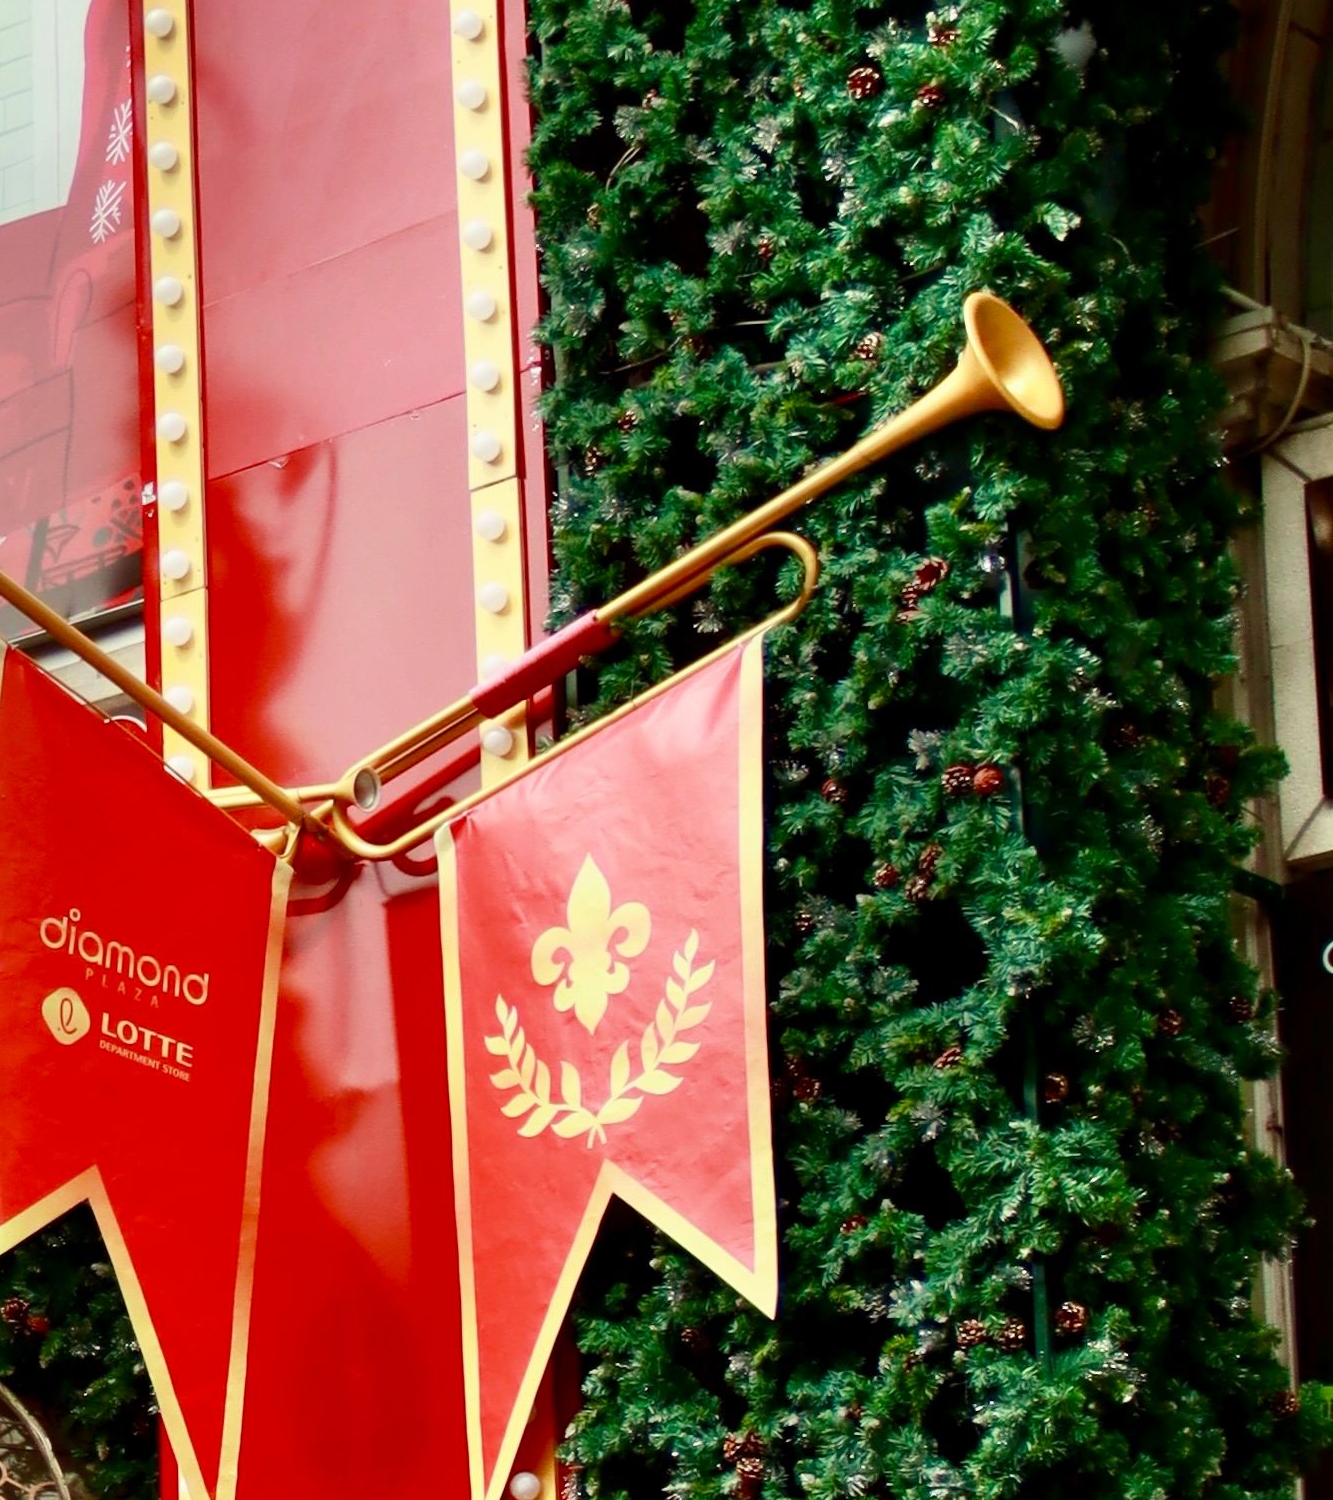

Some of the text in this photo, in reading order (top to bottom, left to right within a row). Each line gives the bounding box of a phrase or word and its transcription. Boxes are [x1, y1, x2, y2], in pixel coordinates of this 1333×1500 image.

[39, 907, 210, 1006] diamond
[85, 967, 160, 1009] PLAZA
[99, 1039, 191, 1083] DEPARTMENT STORE
[101, 1012, 194, 1068] LOTTE
